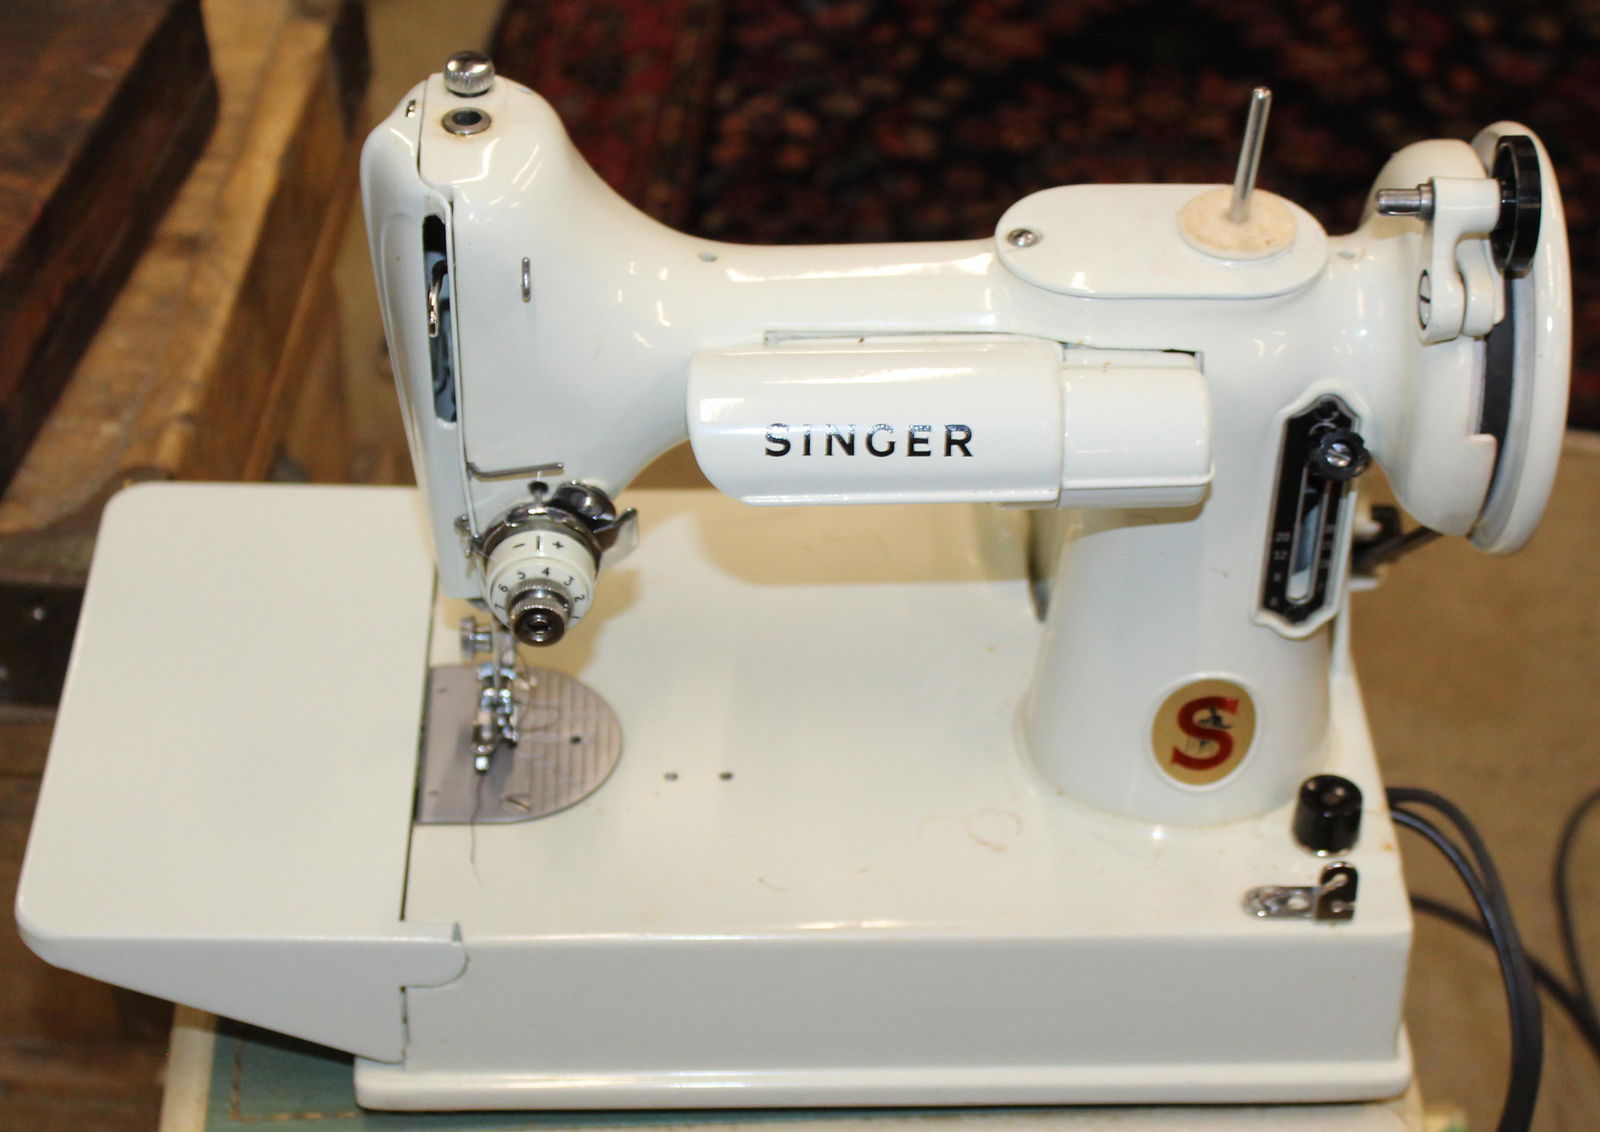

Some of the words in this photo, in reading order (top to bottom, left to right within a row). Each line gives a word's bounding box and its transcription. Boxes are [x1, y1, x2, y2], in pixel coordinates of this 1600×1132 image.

[764, 423, 973, 457] SINGER
[517, 571, 526, 580] 5
[541, 567, 550, 577] 4
[563, 576, 574, 587] 3
[497, 584, 508, 593] 6
[574, 594, 585, 603] 2
[494, 603, 506, 611] 7
[1170, 695, 1239, 771] S
